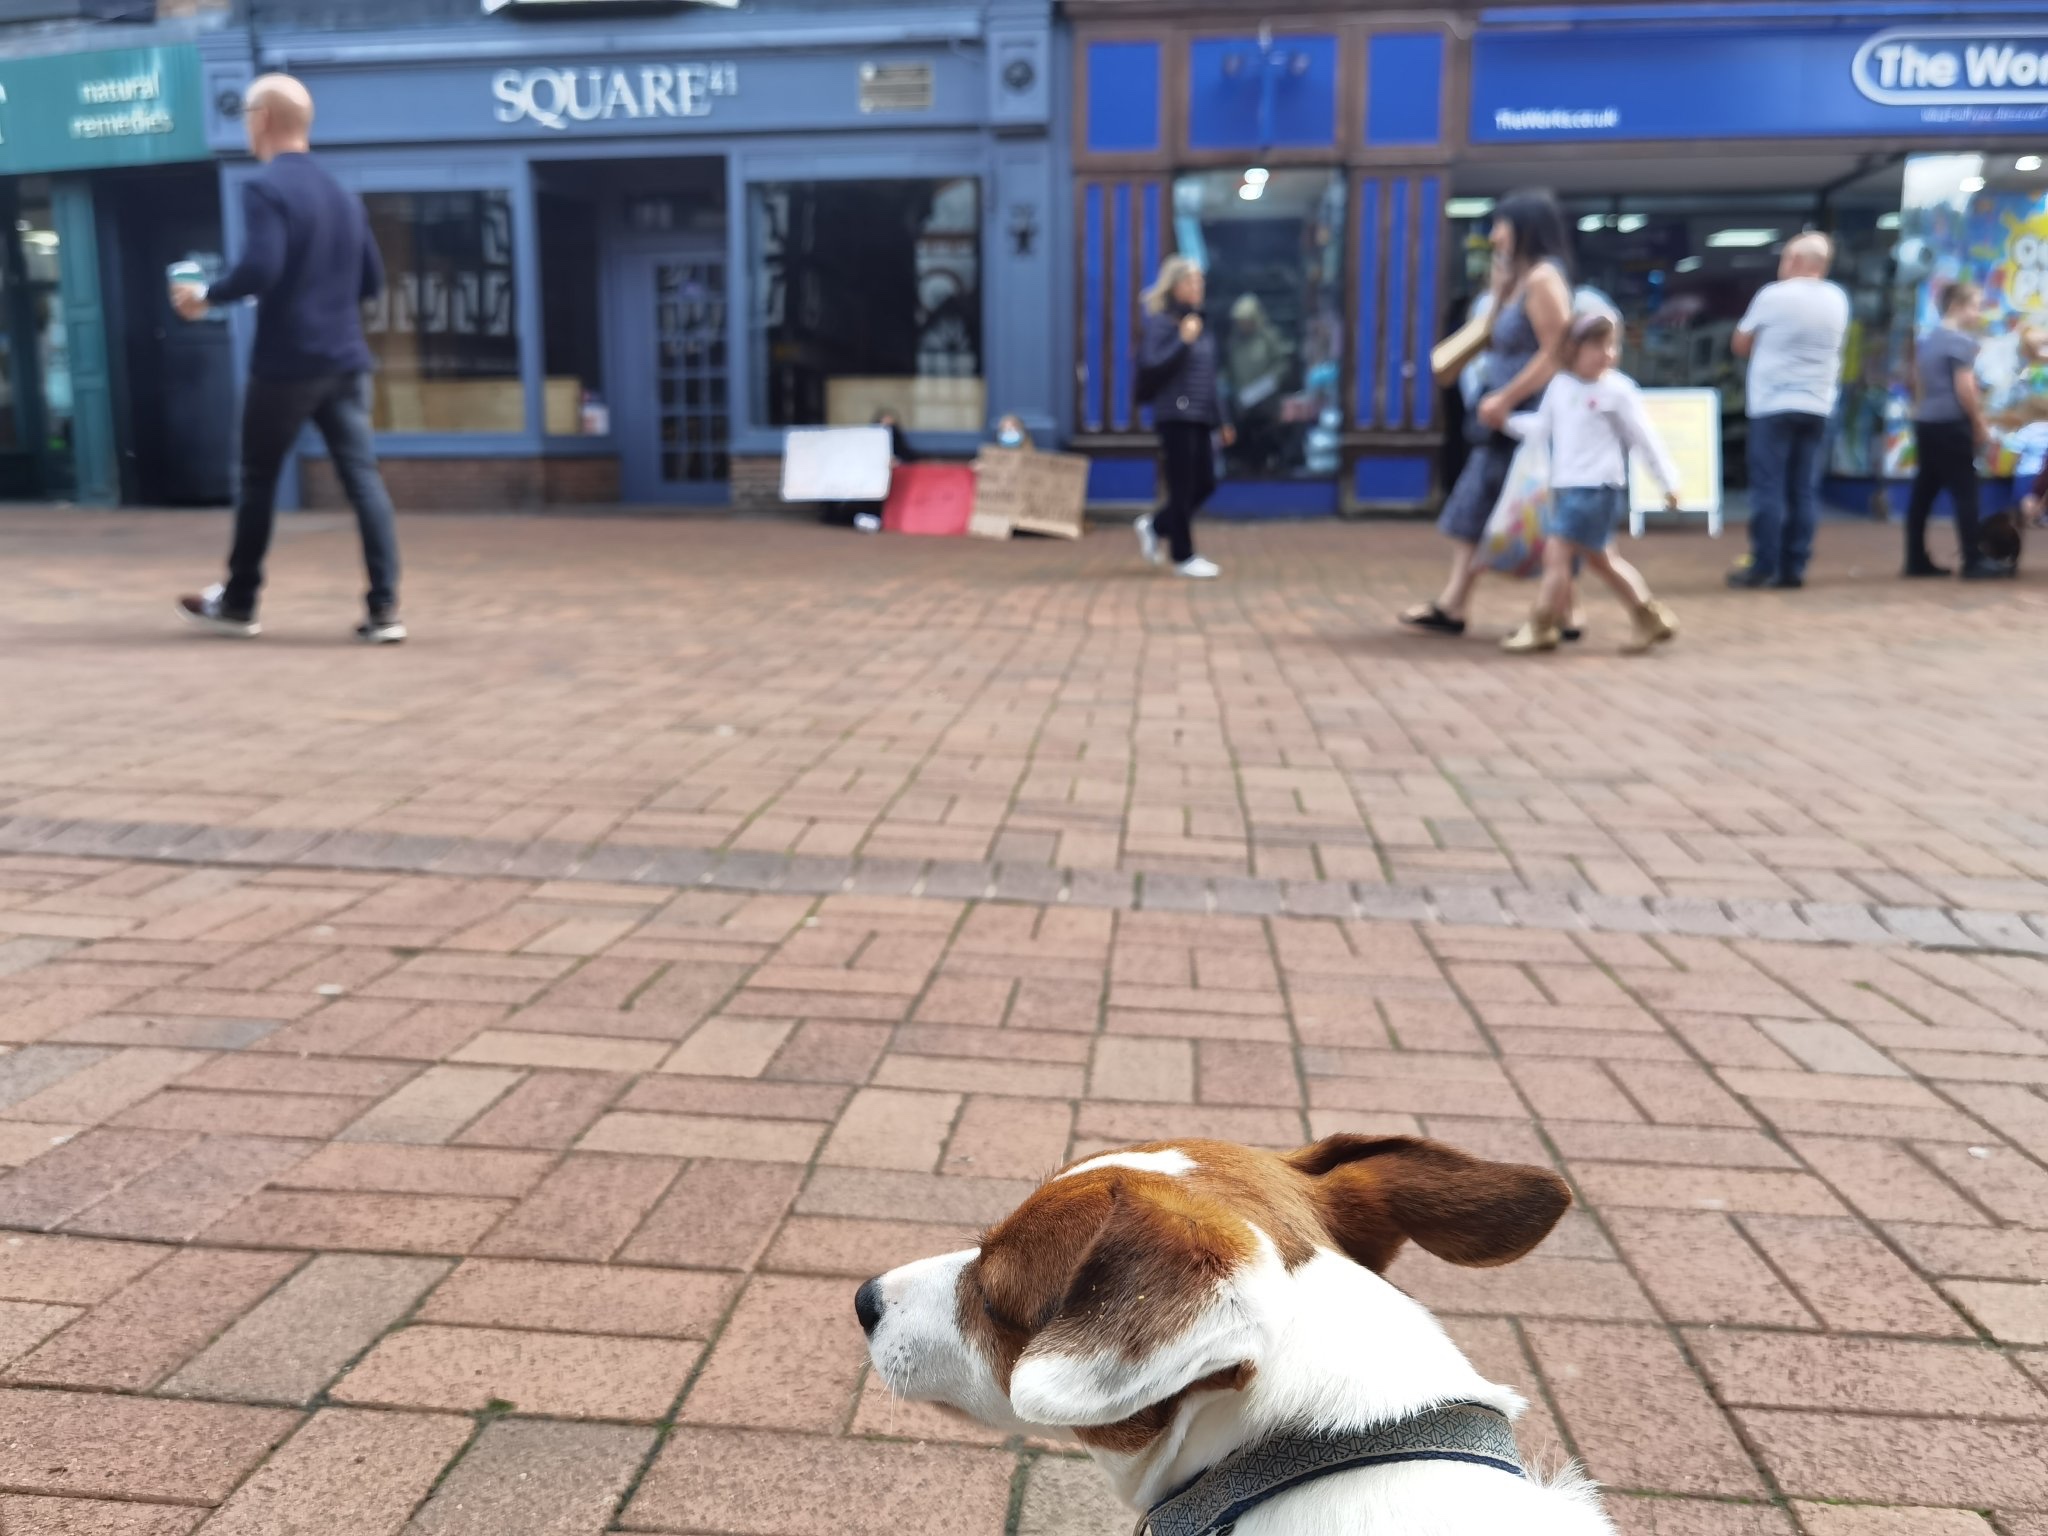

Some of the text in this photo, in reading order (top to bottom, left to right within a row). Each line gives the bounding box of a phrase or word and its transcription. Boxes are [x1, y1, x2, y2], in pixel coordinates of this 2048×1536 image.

[1875, 45, 1959, 88] The
[82, 70, 161, 104] natural
[492, 64, 711, 130] SQUARE
[72, 109, 174, 139] remedies
